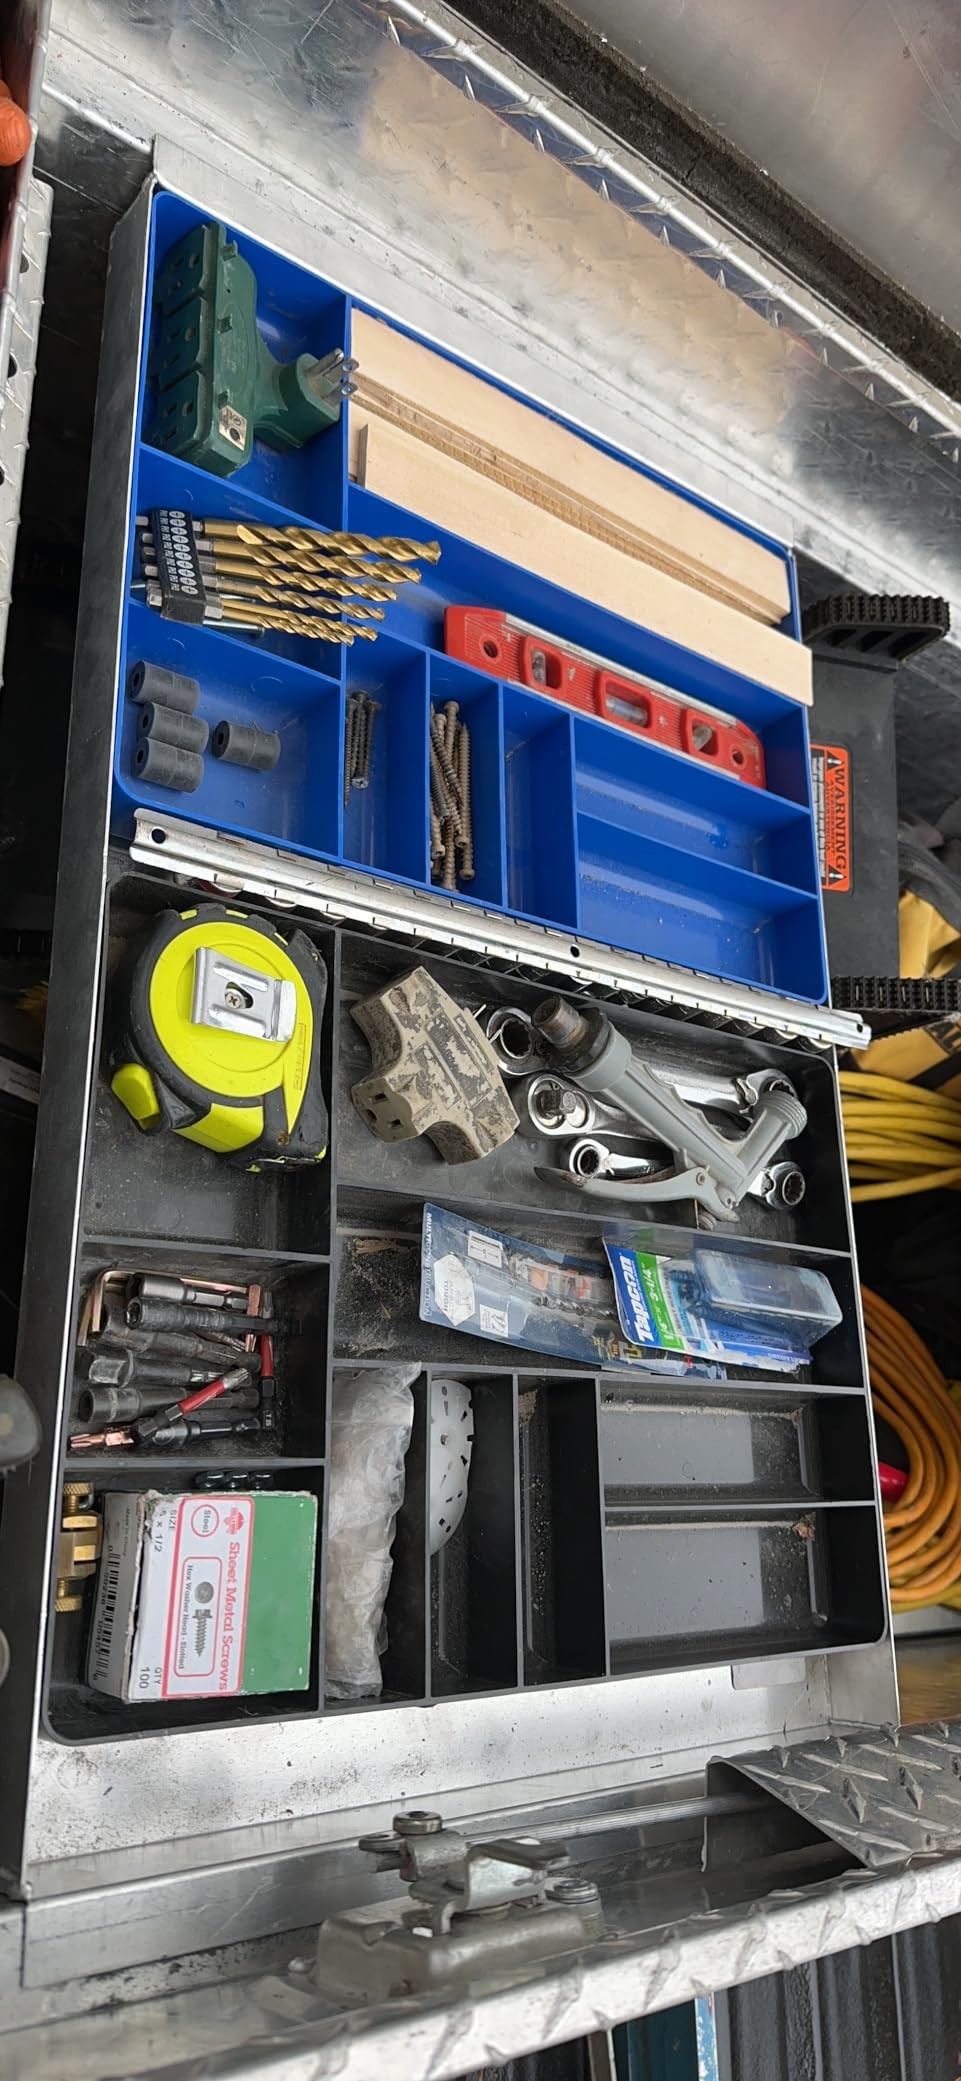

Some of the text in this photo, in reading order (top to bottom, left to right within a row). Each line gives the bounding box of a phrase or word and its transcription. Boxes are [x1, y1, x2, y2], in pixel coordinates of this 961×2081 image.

[835, 768, 846, 869] WARNING
[620, 1255, 654, 1342] Tapcon
[169, 1510, 177, 1531] SIZE
[202, 1509, 211, 1533] Steel
[154, 1535, 163, 1552] 1/2
[184, 1582, 192, 1614] Washer
[181, 1614, 189, 1635] Head
[219, 1542, 240, 1690] Sheet Metal Screws
[178, 1641, 186, 1669] Slotted
[139, 1667, 150, 1689] 100
[154, 1667, 162, 1684] QTY
